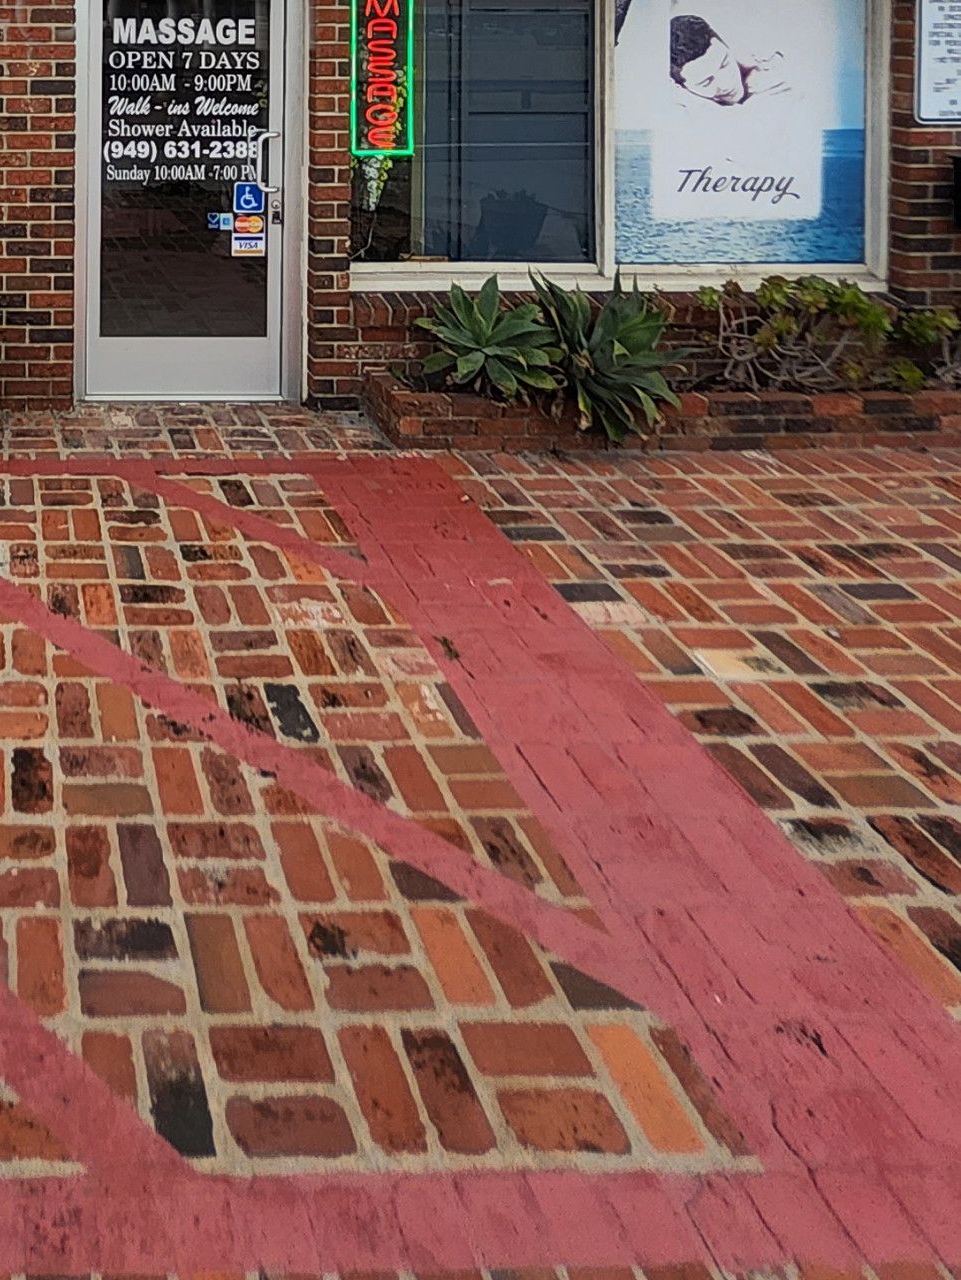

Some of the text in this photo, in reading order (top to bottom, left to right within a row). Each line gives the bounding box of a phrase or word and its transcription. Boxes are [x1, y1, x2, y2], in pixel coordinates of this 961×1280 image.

[113, 17, 256, 45] MASSAGE
[108, 51, 260, 69] OPEN 7 DAYS
[109, 73, 176, 91] 10:00AM
[194, 73, 252, 91] 9:00PM
[108, 95, 151, 116] Walk
[167, 99, 190, 116] ins
[194, 95, 259, 116] Welcome
[108, 119, 257, 137] Shower Available
[103, 140, 258, 163] (949) 631-2388
[106, 164, 151, 185] Sunday
[154, 164, 206, 180] 10:00AM
[676, 166, 800, 205] Therapy
